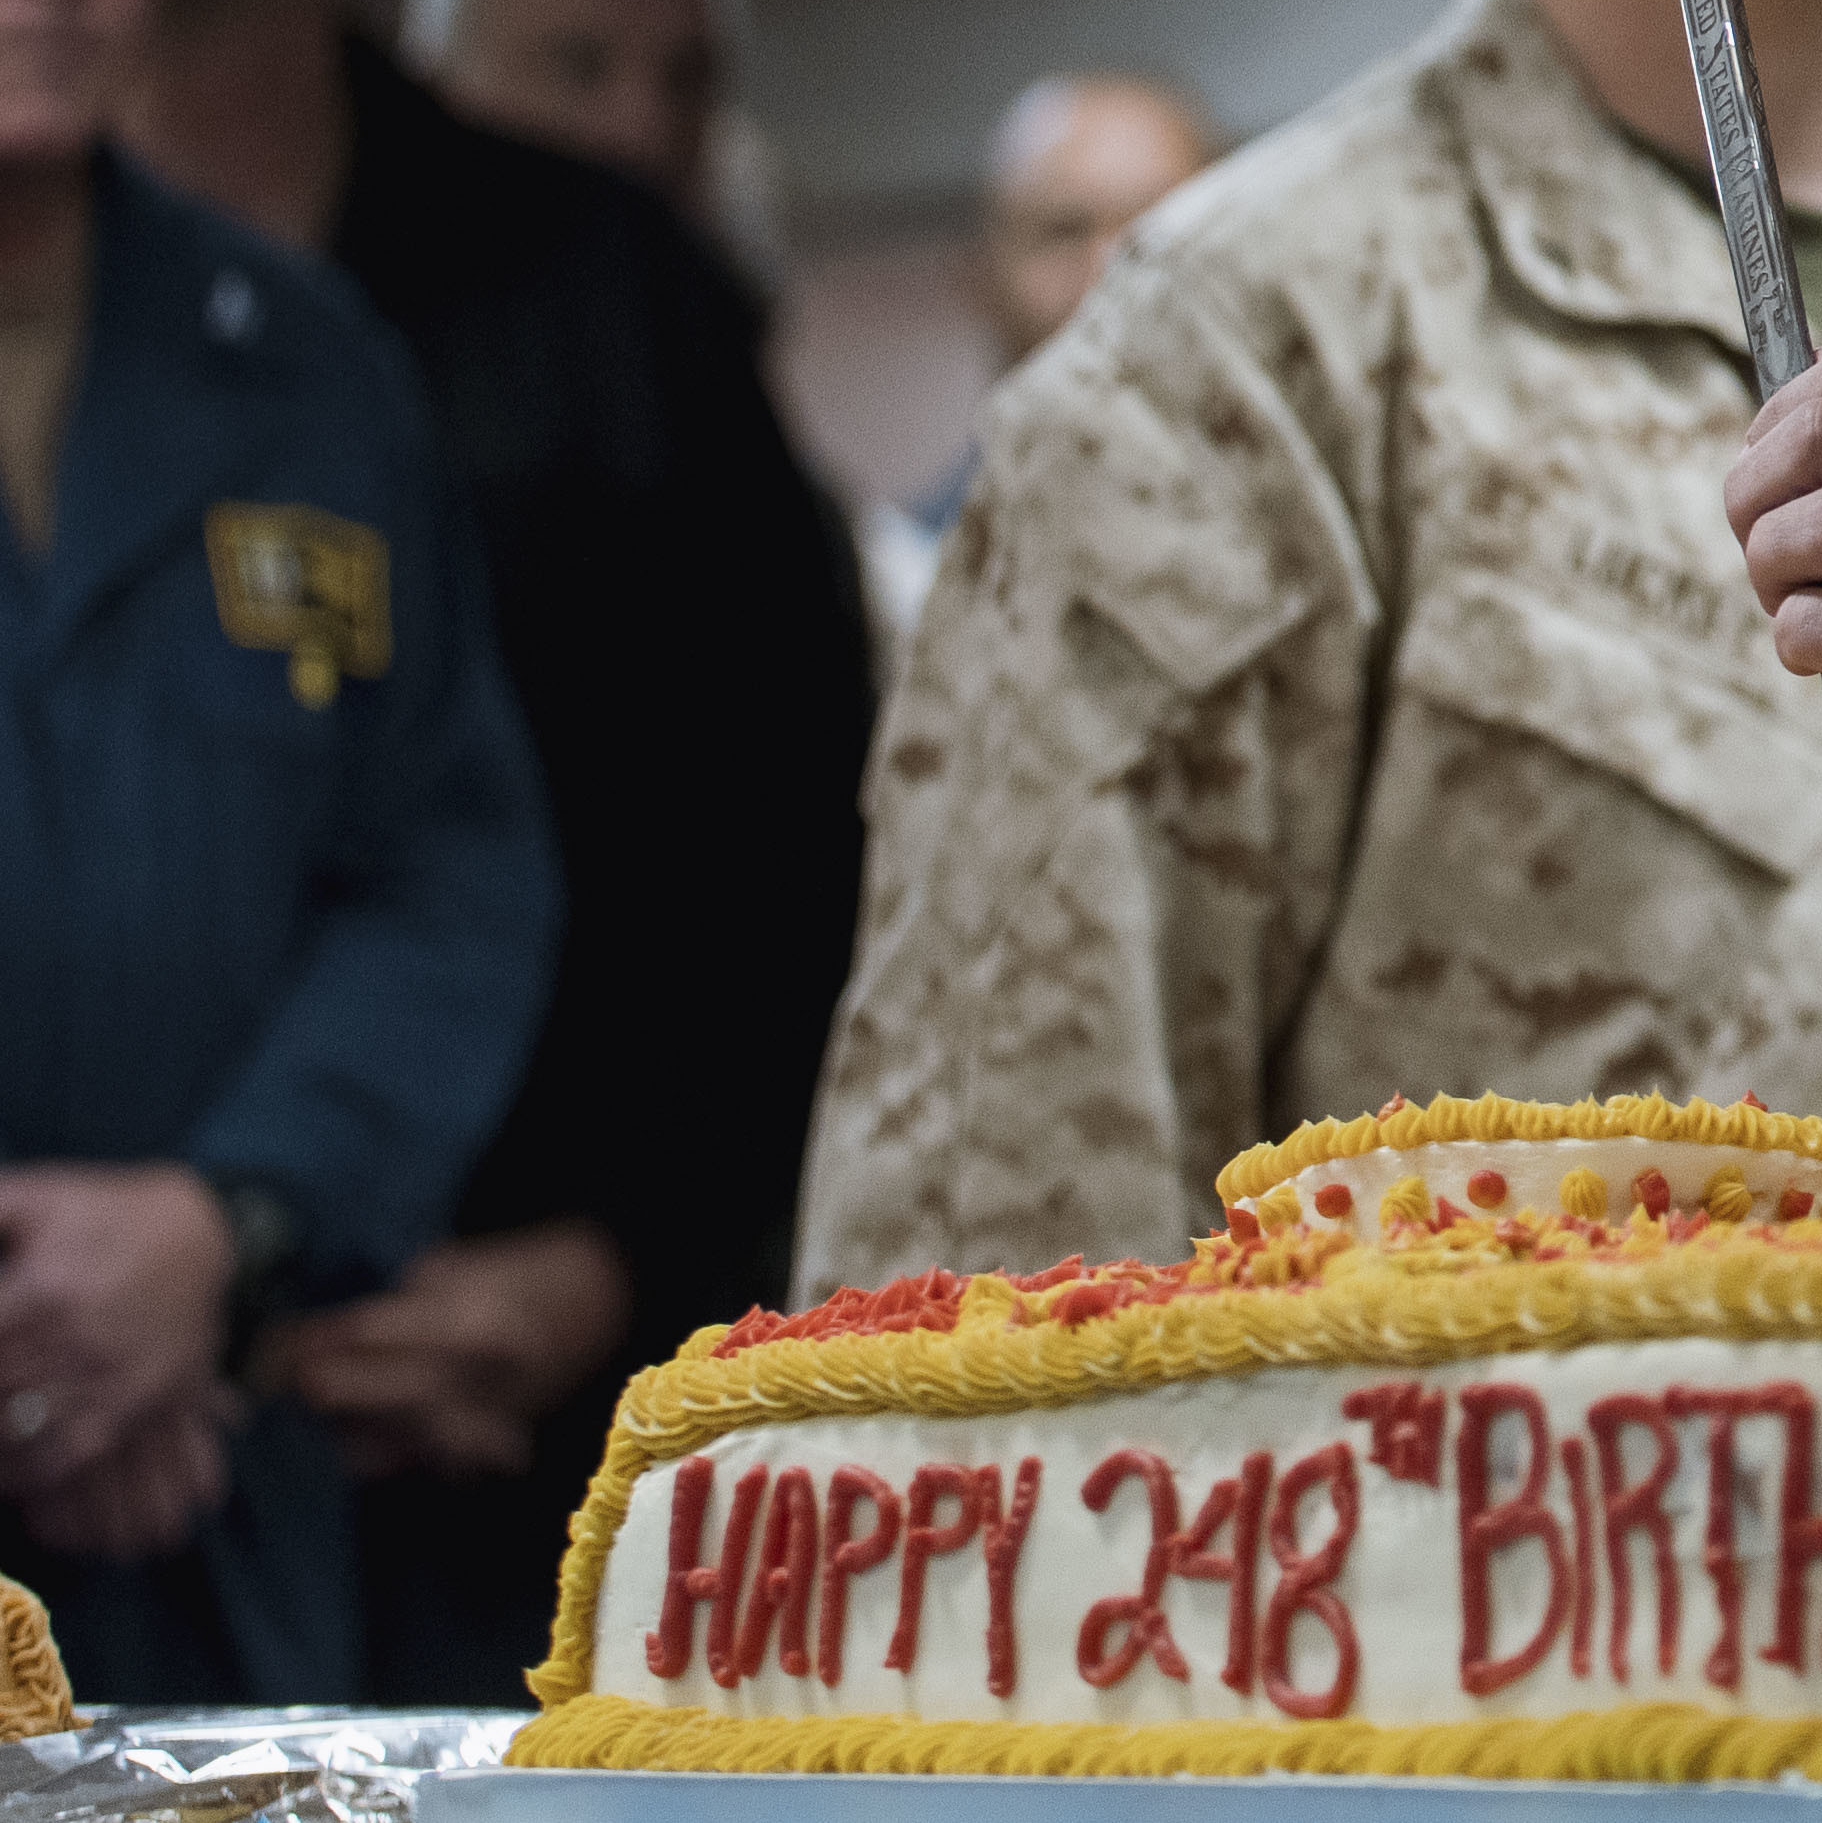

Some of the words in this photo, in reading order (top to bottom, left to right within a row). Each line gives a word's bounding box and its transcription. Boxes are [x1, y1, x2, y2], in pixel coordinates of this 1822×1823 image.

[1696, 28, 1741, 150] STATES
[1719, 143, 1769, 295] MARINES
[644, 1455, 1043, 1697] HAPPY
